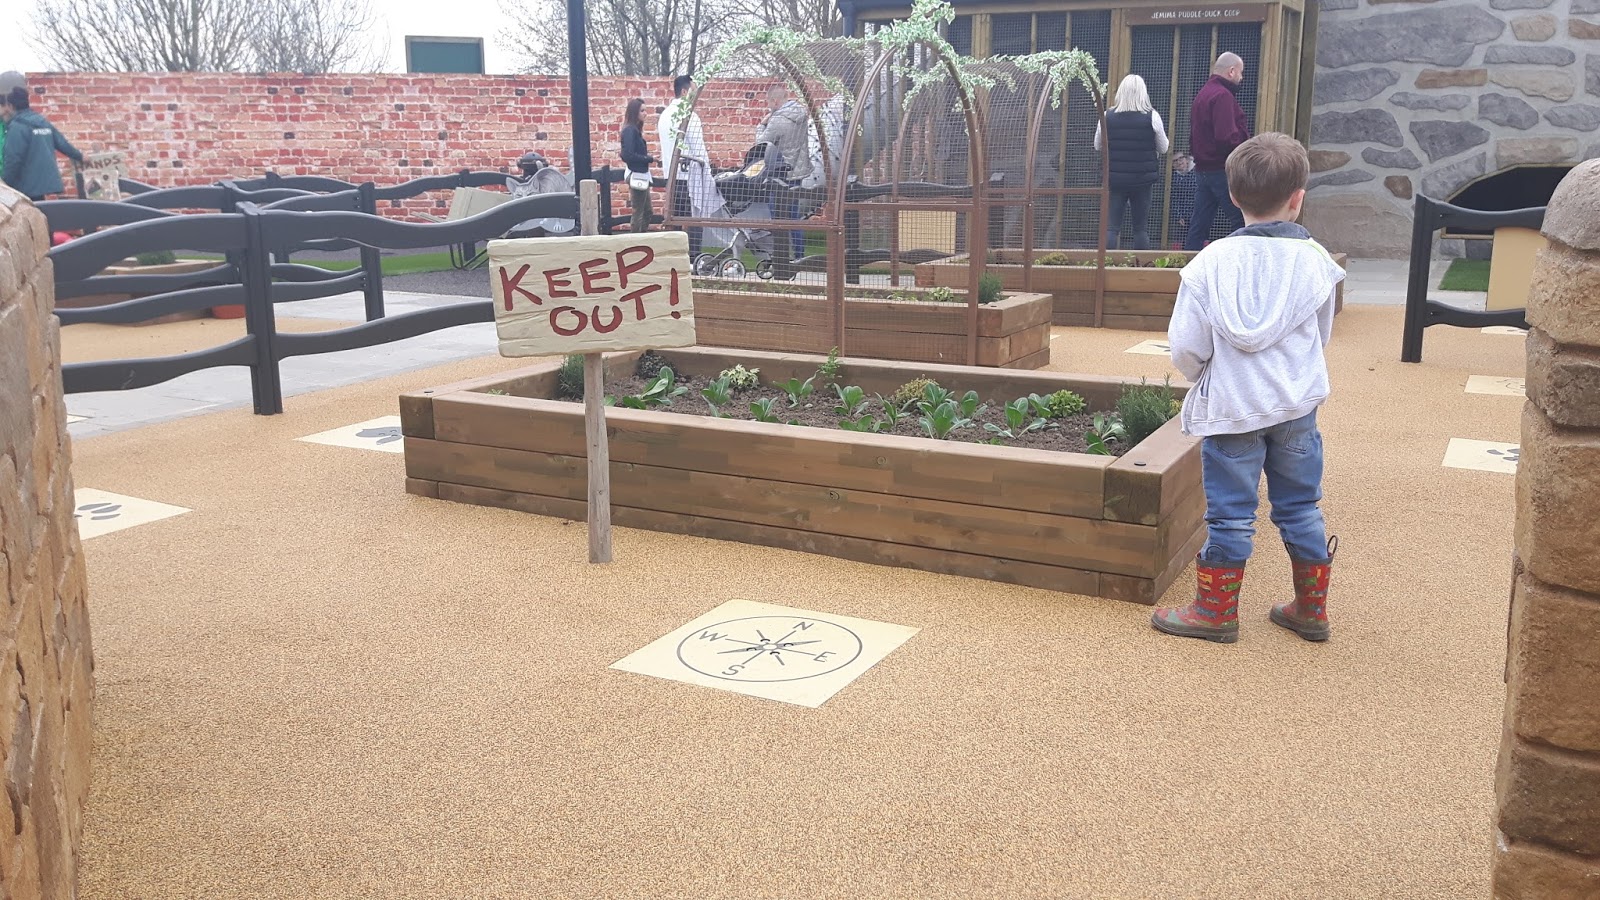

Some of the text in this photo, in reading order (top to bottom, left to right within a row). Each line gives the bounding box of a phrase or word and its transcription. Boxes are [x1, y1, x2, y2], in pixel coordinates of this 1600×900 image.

[1151, 11, 1176, 19] JEMIMA
[499, 245, 655, 311] KEEP
[549, 267, 681, 336] OUT!
[793, 621, 815, 632] N
[698, 630, 728, 642] W
[813, 651, 837, 663] E
[721, 664, 746, 676] S
